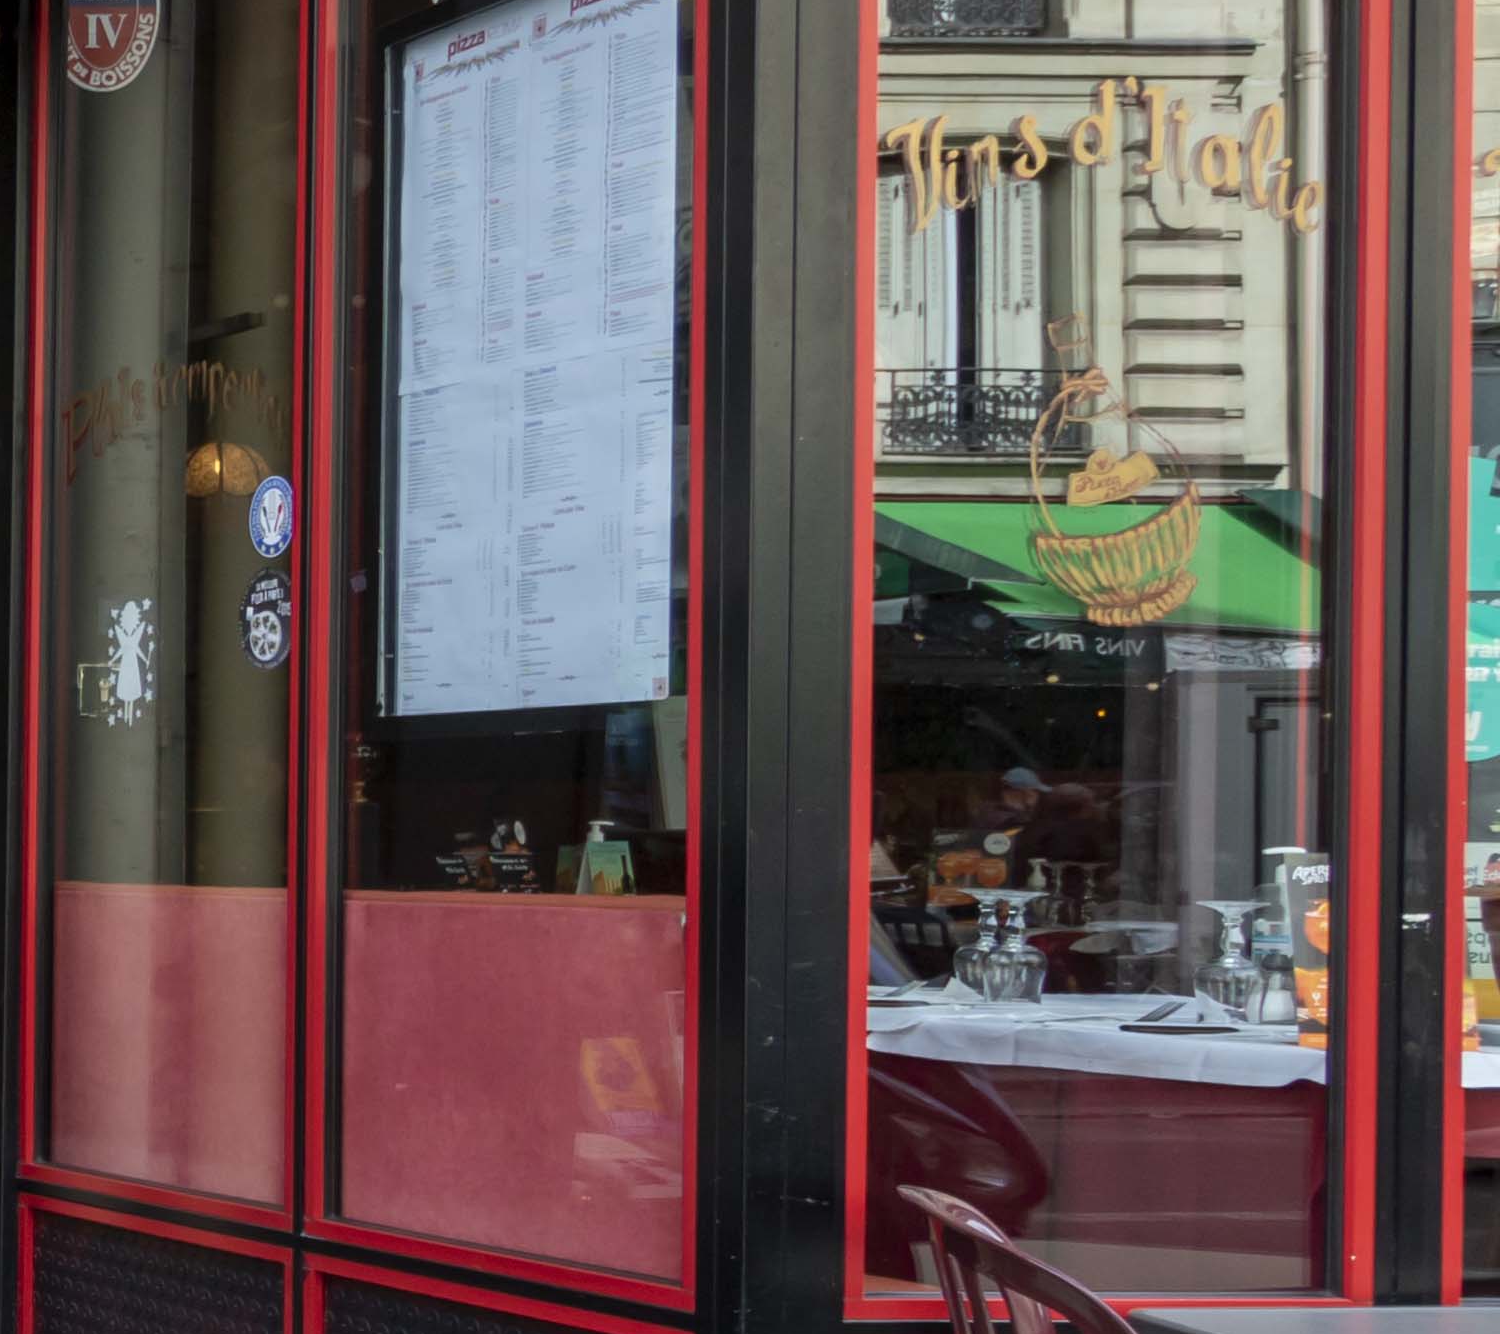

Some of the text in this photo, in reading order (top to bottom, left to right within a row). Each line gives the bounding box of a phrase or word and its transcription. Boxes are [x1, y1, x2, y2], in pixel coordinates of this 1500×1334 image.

[84, 13, 128, 49] IV
[89, 13, 154, 86] BOISSONS
[447, 29, 485, 62] pizza
[884, 75, 1323, 234] Vins d'Italie
